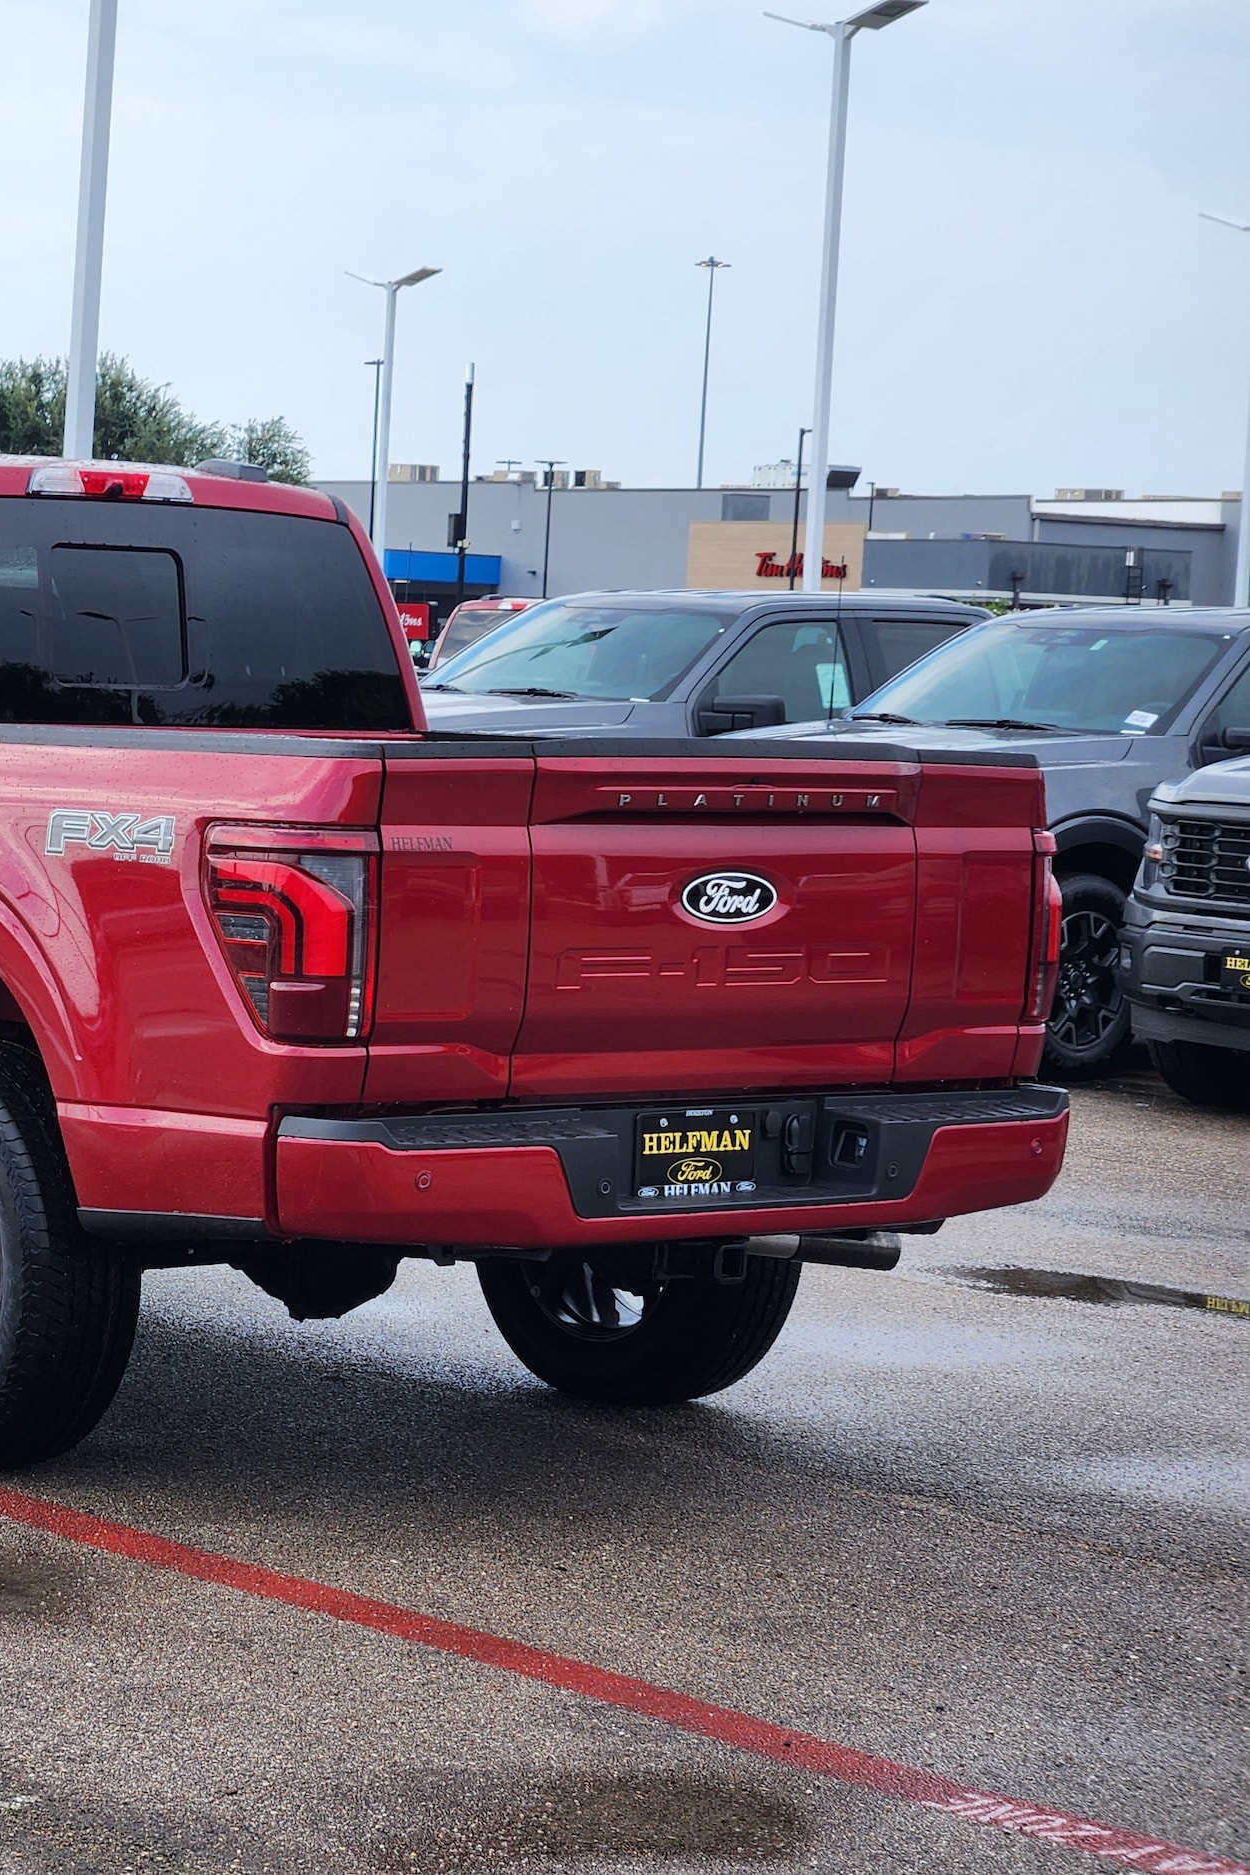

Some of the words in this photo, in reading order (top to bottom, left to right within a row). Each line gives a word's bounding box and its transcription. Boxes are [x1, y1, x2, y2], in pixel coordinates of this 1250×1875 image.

[755, 552, 784, 577] Tim
[785, 552, 847, 578] Hons
[618, 793, 881, 809] PLATINUM
[45, 808, 175, 856] FX4
[391, 836, 453, 851] HELFMAN
[699, 878, 760, 914] Ford
[556, 946, 889, 989] F-150
[642, 1129, 752, 1155] HELFMAN
[677, 1160, 713, 1181] Ford
[664, 1181, 732, 1197] HELFMAN
